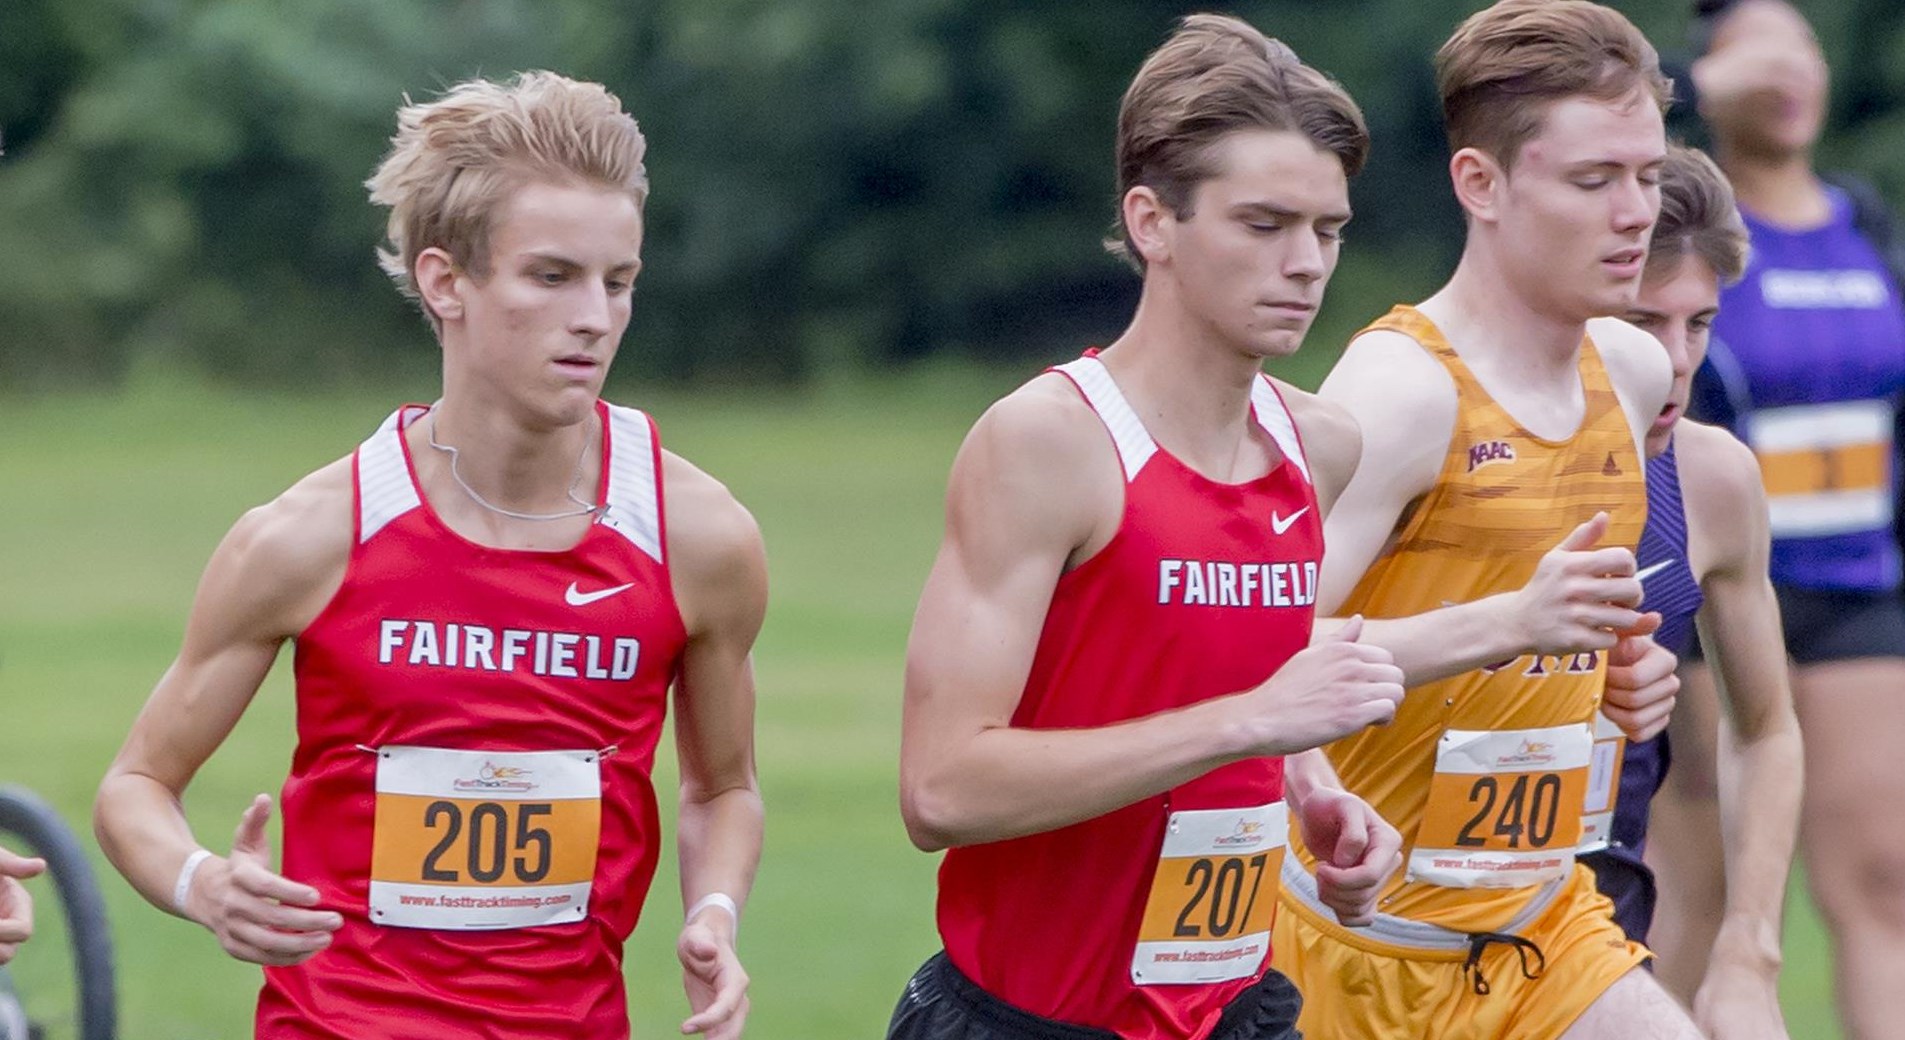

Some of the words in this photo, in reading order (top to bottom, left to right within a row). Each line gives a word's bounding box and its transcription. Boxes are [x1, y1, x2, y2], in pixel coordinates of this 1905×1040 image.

[1467, 441, 1513, 472] MAAC
[1157, 558, 1318, 608] FAIRFIELD
[378, 618, 640, 681] FAIRFIELD
[421, 800, 553, 883] 205
[1454, 773, 1561, 848] 240
[399, 894, 572, 909] www.fasttracktiming.com
[1173, 854, 1267, 937] 207
